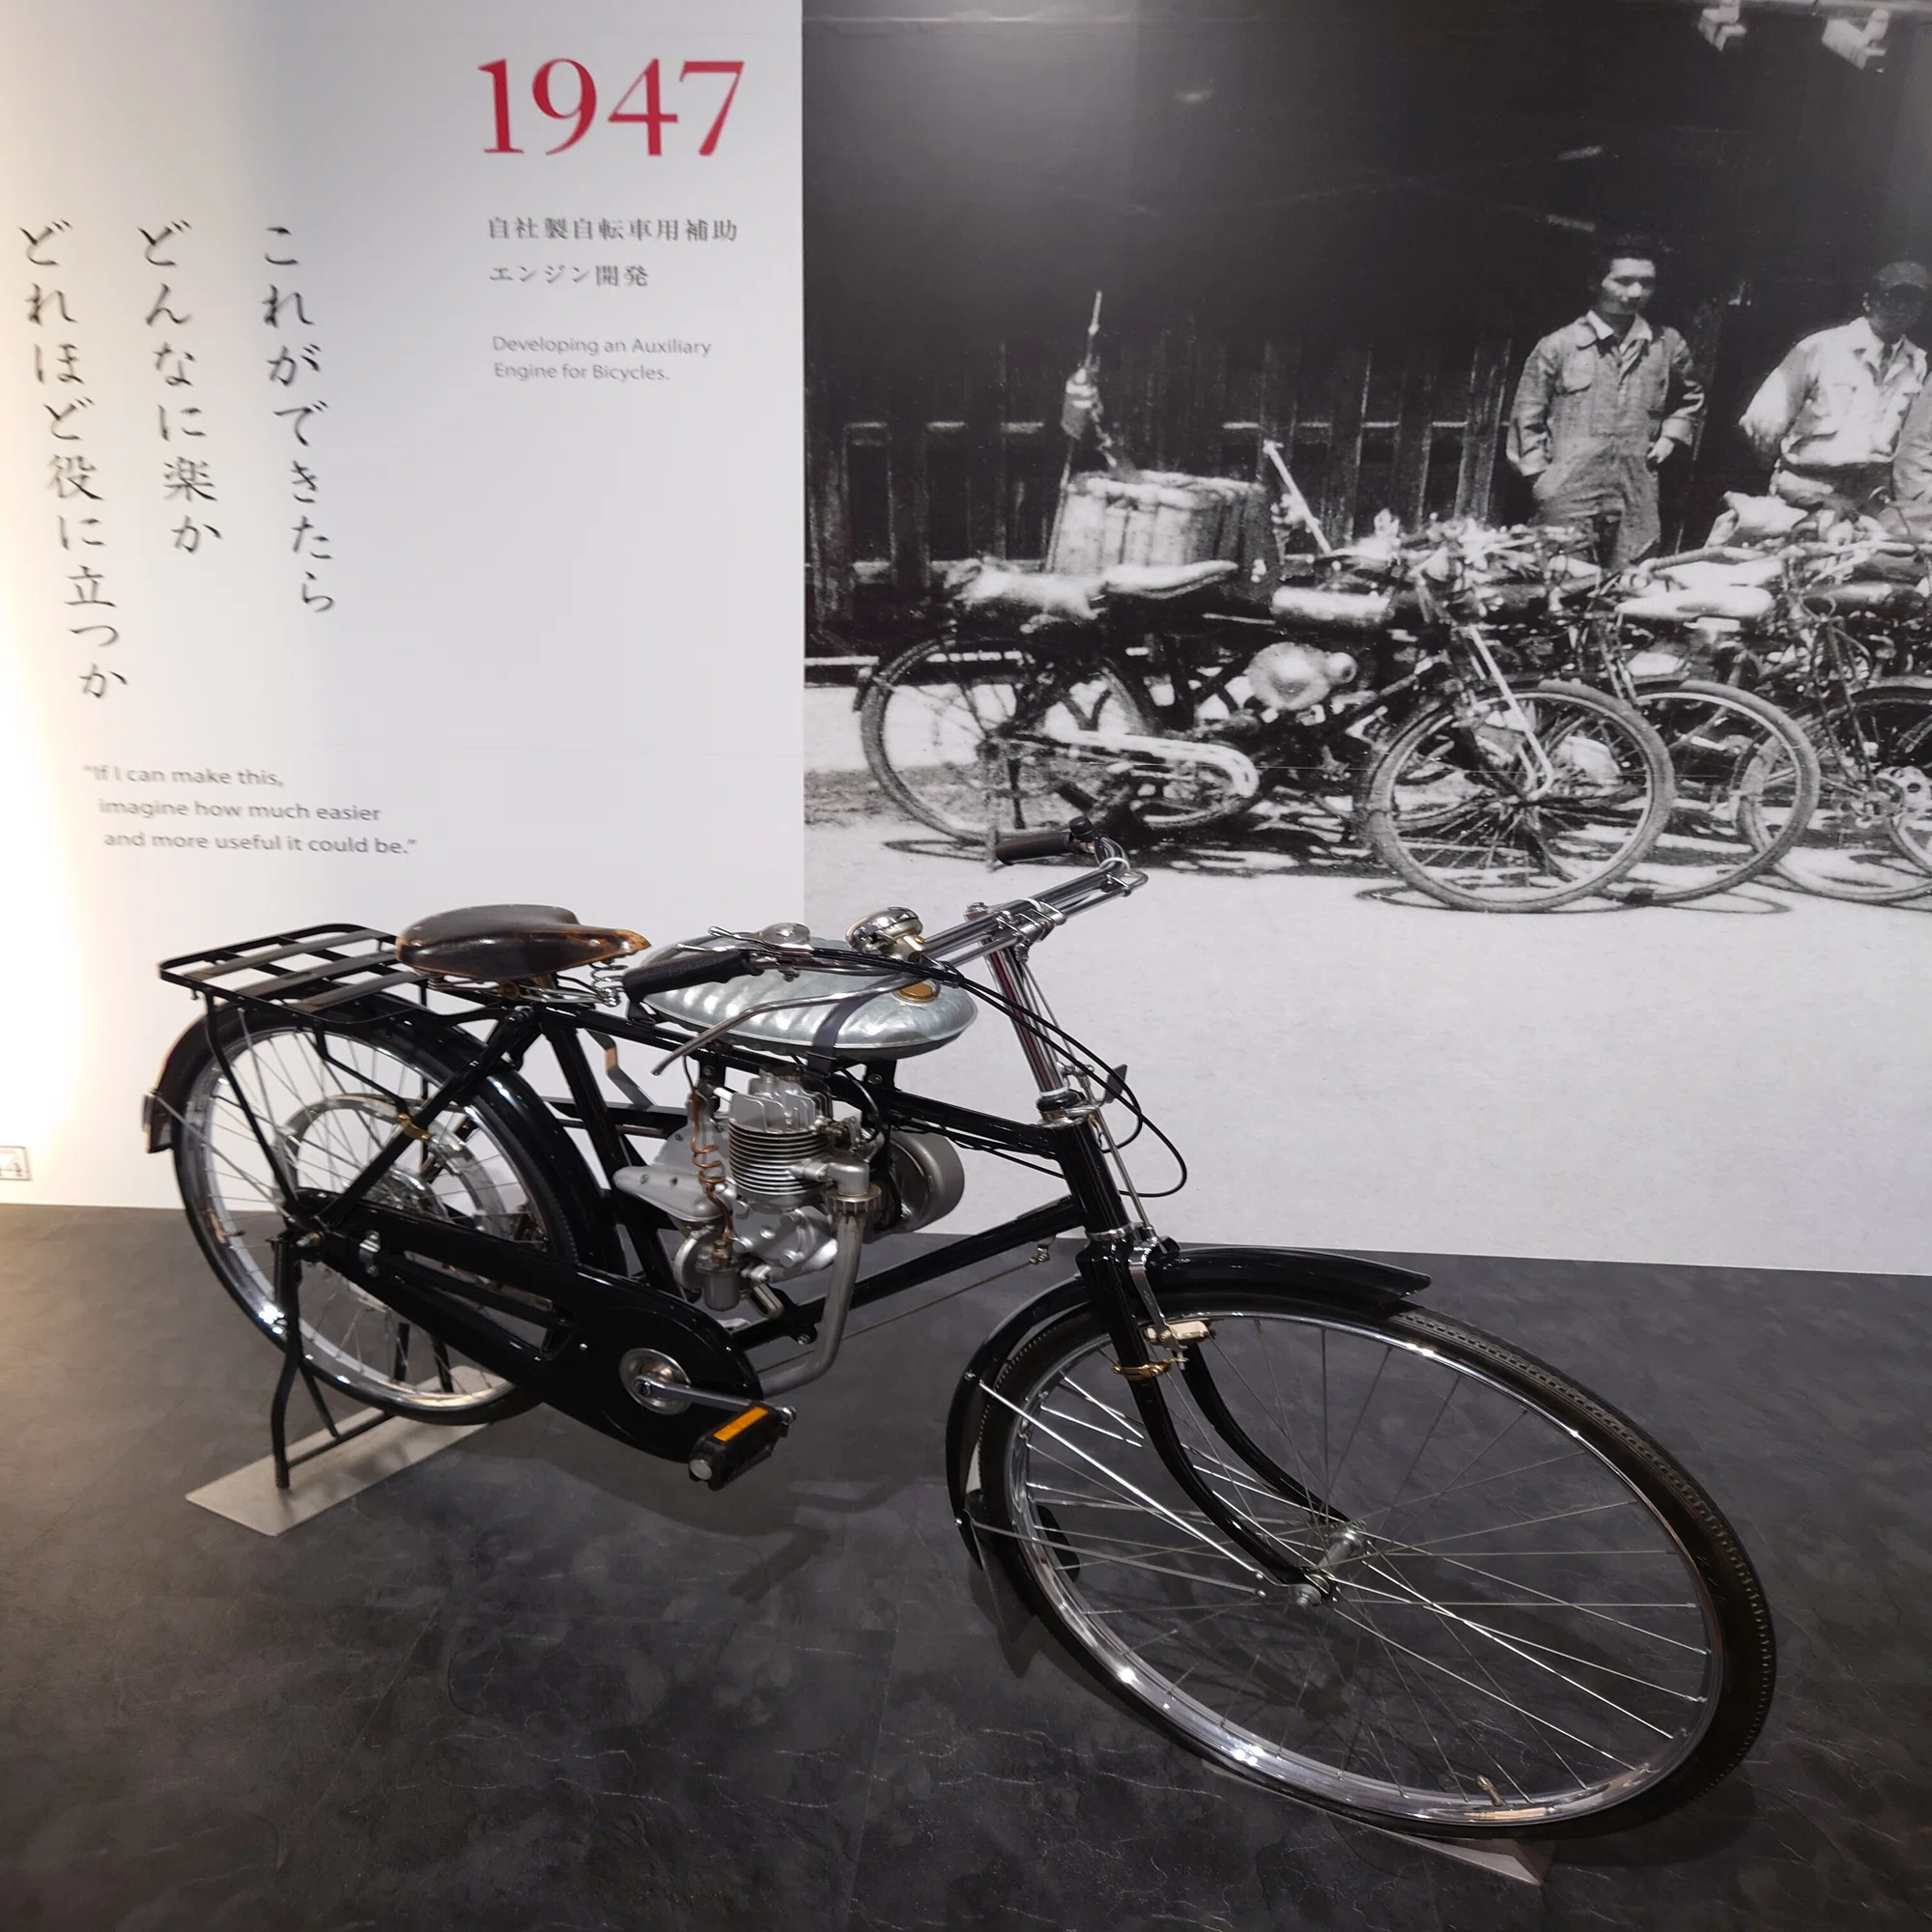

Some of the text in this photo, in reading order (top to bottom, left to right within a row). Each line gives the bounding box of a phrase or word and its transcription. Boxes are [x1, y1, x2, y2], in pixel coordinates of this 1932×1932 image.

[477, 58, 745, 156] 1947
[488, 216, 738, 242] 自社製自転車用補助
[489, 264, 649, 287] エンジン開発
[493, 335, 712, 358] Developing an Auxiliary
[137, 218, 222, 554] どんなに楽か
[494, 362, 670, 384] Engine for Bicycles.
[262, 226, 335, 612] これができたら
[18, 218, 128, 699] どれほど役に立つか
[126, 769, 166, 782] can
[170, 768, 233, 785] make
[236, 769, 286, 788] this,
[99, 797, 383, 823] imagine how much easier
[103, 830, 147, 847] and
[151, 835, 210, 850] more
[213, 833, 283, 852] useful
[287, 835, 302, 852] it
[307, 835, 370, 854] could
